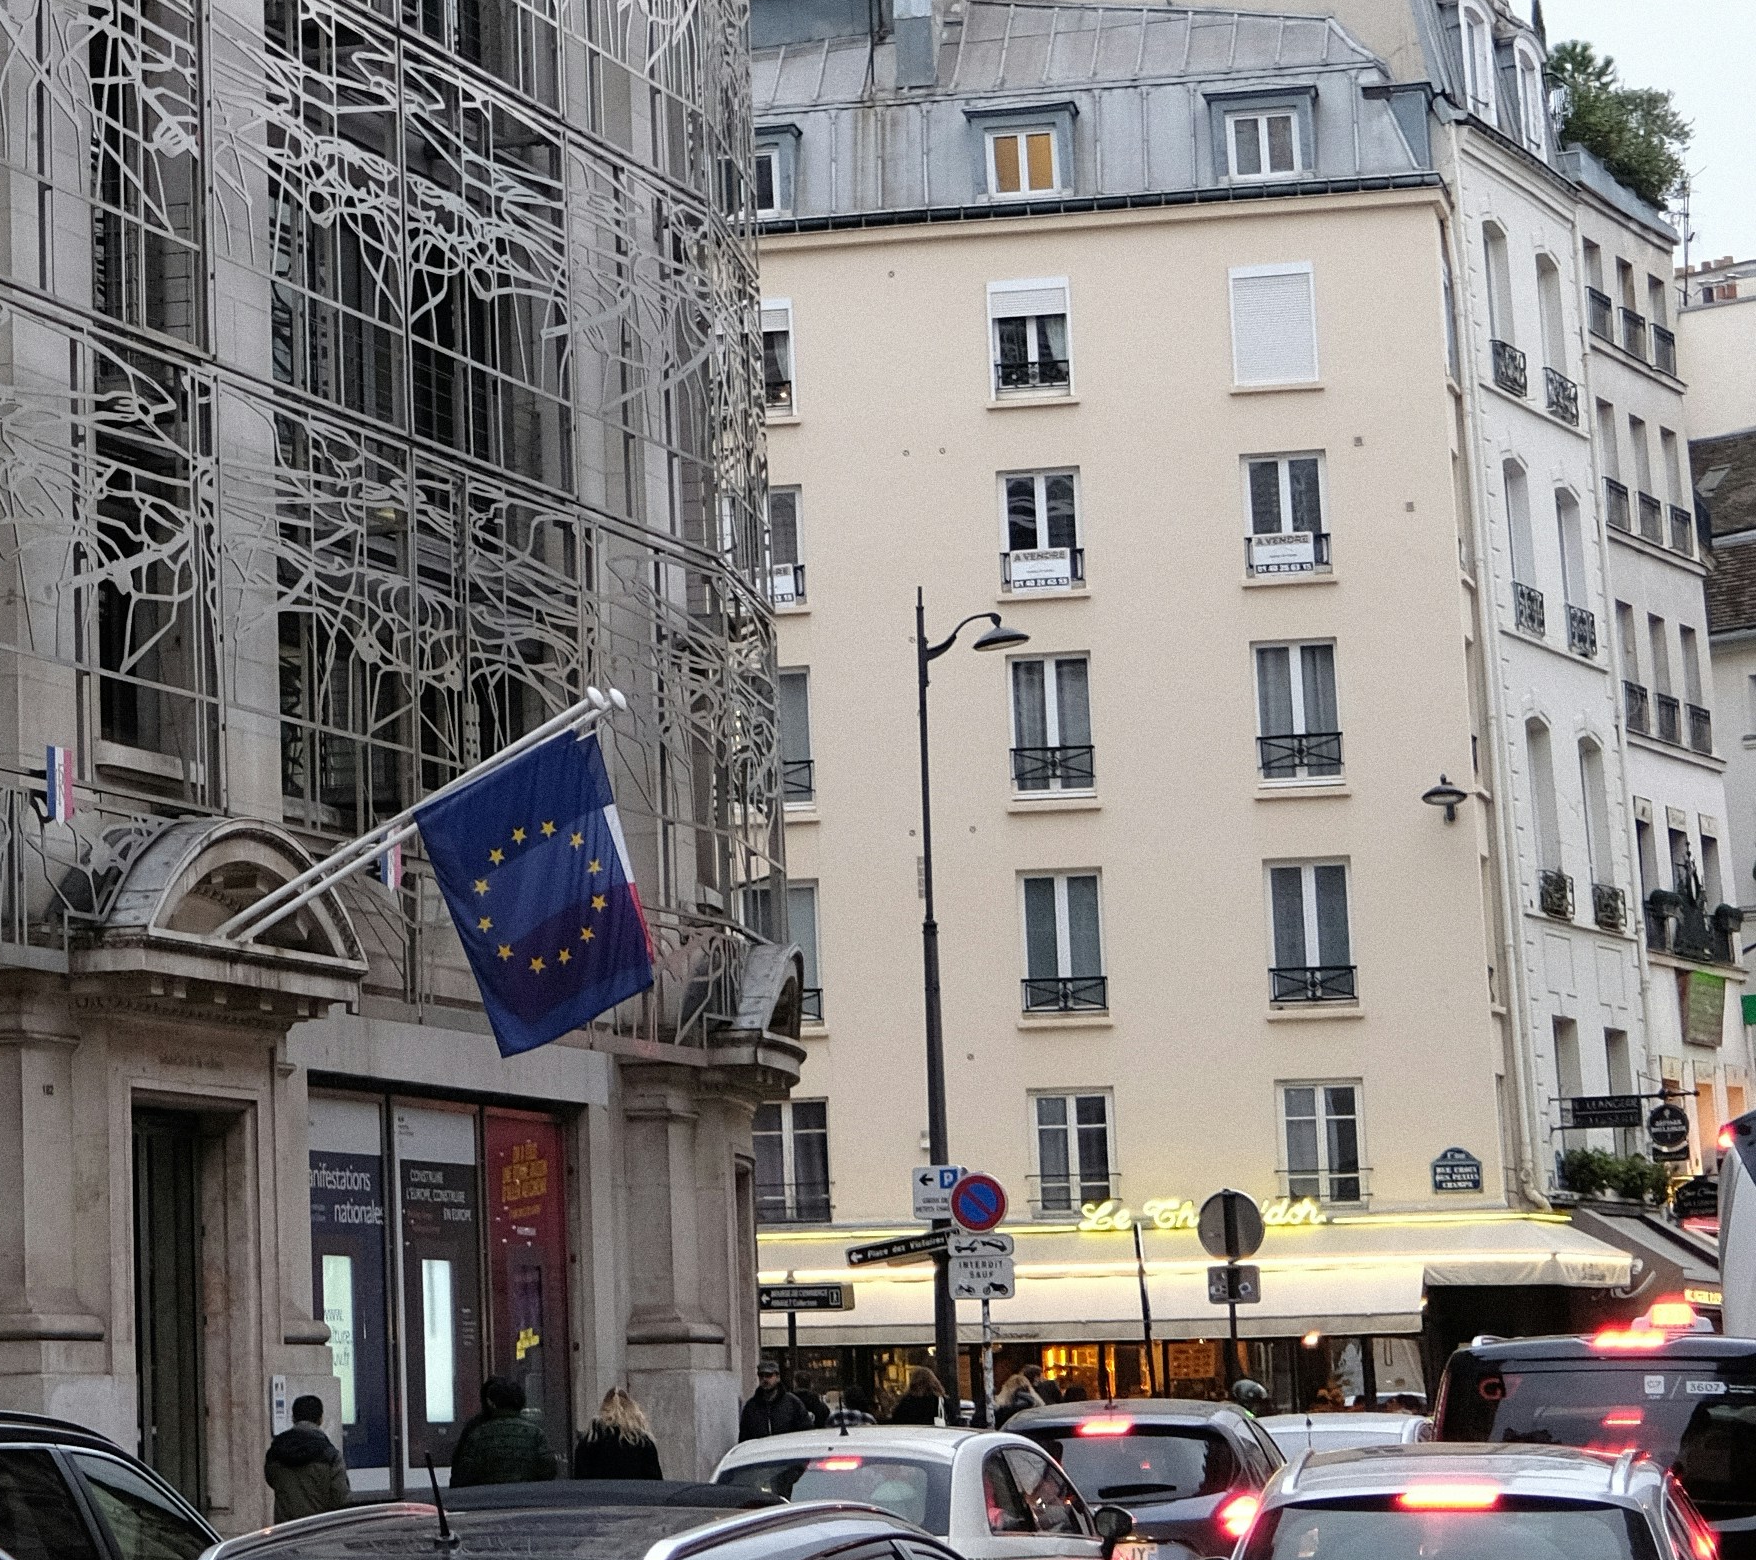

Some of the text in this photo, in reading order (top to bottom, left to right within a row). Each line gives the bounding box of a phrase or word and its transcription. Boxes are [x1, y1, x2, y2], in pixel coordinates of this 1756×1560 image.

[1265, 534, 1309, 545] VENDRE
[1023, 550, 1066, 561] VENDRE
[309, 1162, 371, 1192] anifestations
[1078, 1198, 1132, 1231] Le
[867, 1236, 945, 1259] Place des Victoires
[958, 1260, 1003, 1269] INTERDIT
[969, 1270, 994, 1279] SAUF
